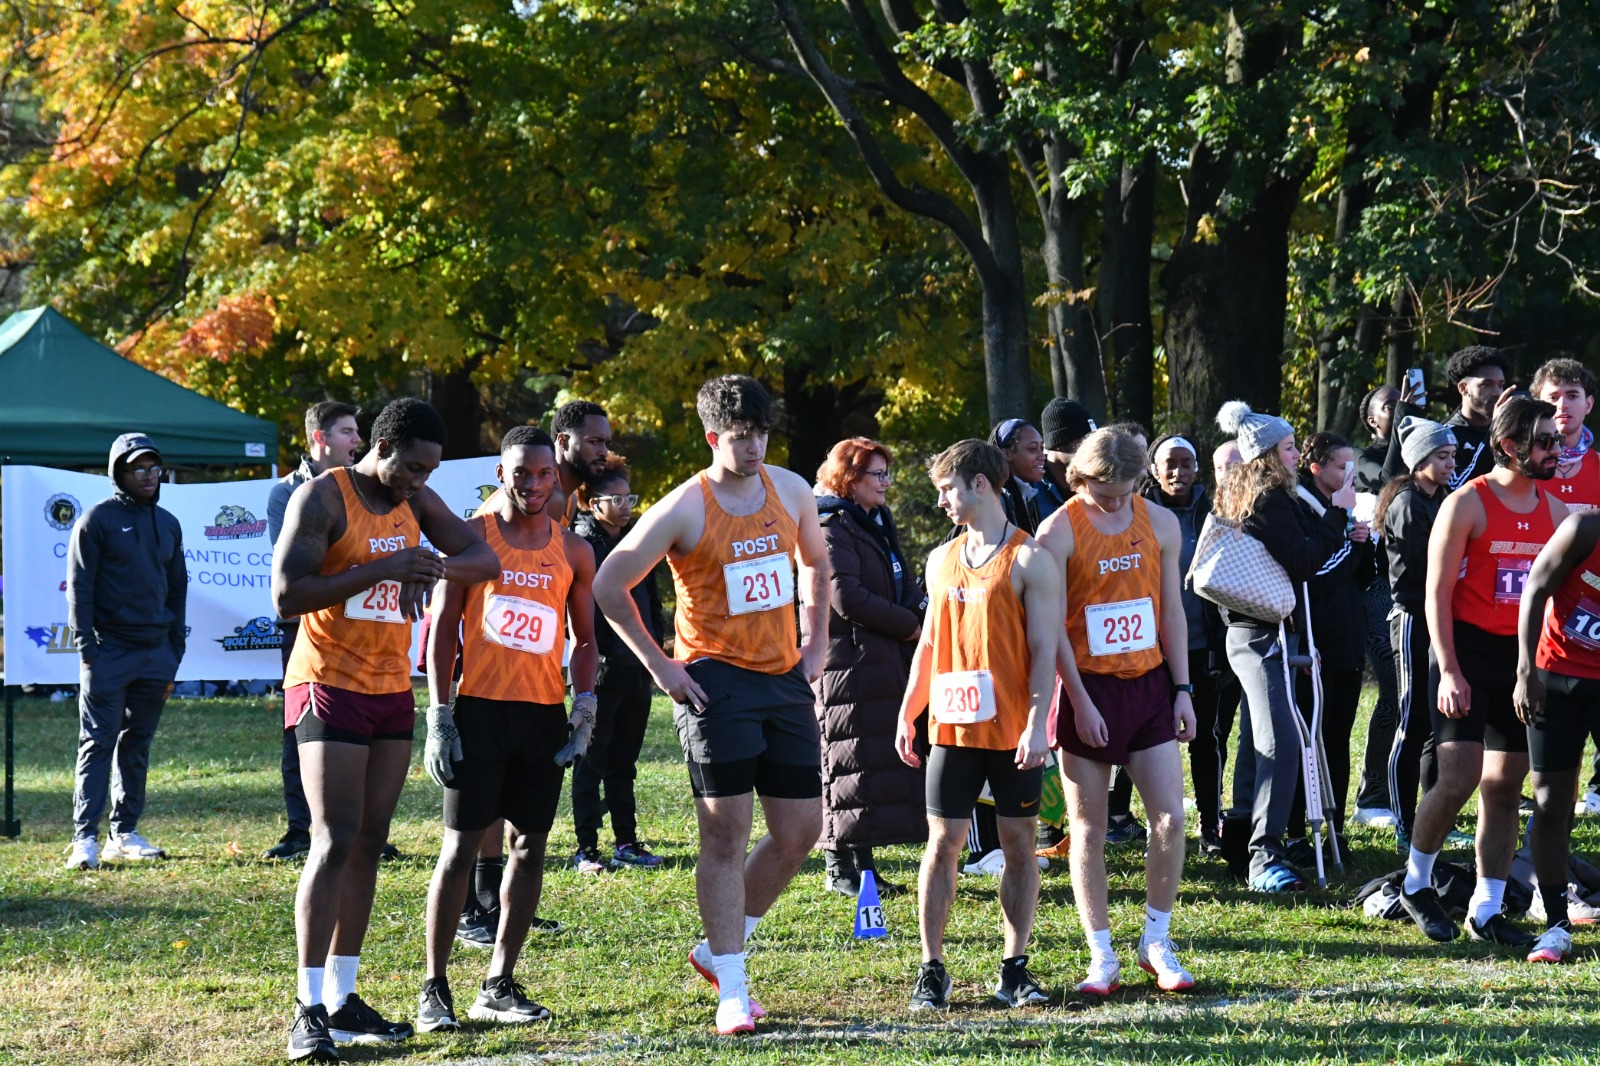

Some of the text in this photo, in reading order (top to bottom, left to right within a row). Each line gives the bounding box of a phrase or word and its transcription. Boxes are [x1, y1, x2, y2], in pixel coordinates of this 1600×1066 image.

[368, 535, 406, 553] POST
[731, 534, 779, 557] POST
[184, 549, 240, 565] ANTIC
[1098, 553, 1141, 574] POST
[198, 571, 272, 588] COUNT
[502, 570, 552, 590] POST
[743, 570, 781, 602] 231
[363, 583, 399, 611] 233
[947, 586, 987, 603] POST
[500, 610, 543, 642] 229
[1103, 613, 1143, 644] 232
[944, 686, 979, 712] 230
[861, 907, 884, 928] 13
